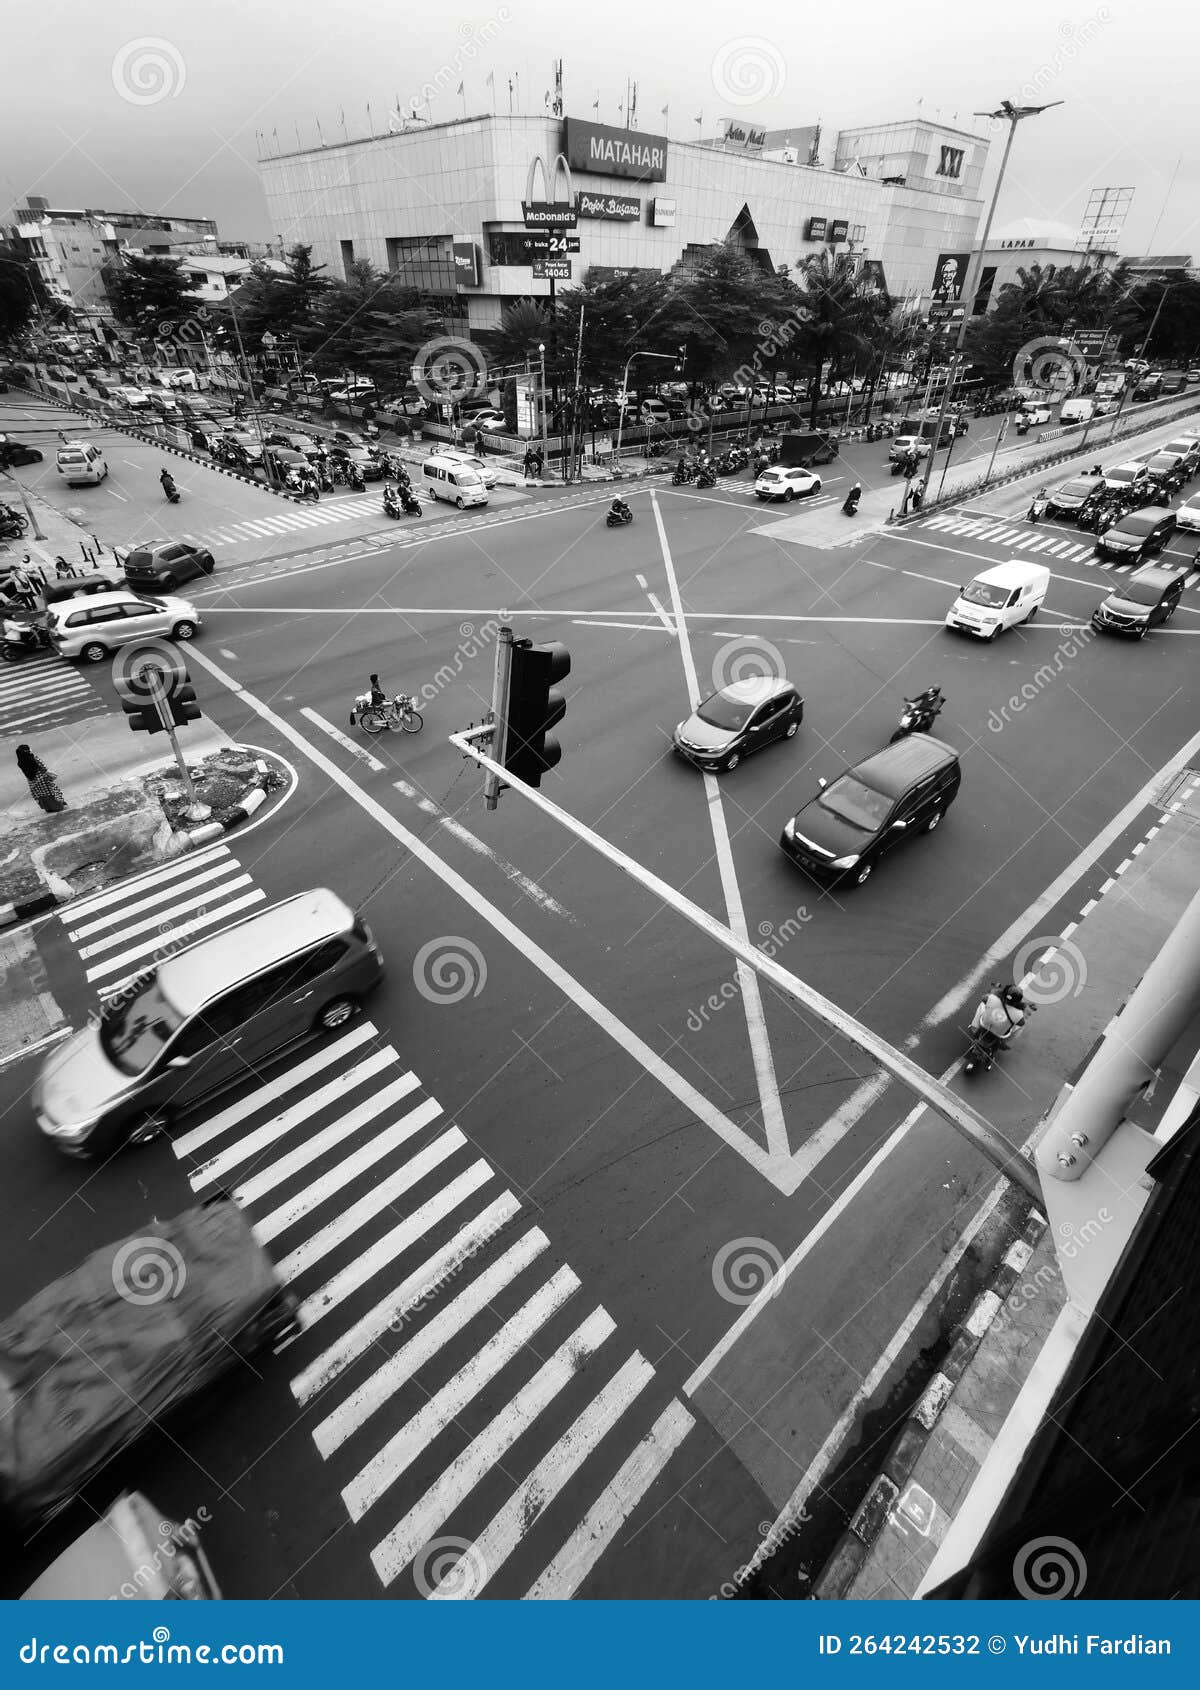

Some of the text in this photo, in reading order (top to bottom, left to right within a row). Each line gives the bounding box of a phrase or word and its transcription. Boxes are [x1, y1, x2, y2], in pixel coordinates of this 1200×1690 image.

[590, 136, 664, 169] MATAHARI
[935, 145, 966, 178] XXI
[581, 196, 641, 216] Pojok Busana
[526, 212, 576, 221] McDonald's
[549, 237, 568, 251] 24
[1001, 239, 1035, 249] LAPAN
[544, 268, 569, 278] 14045
